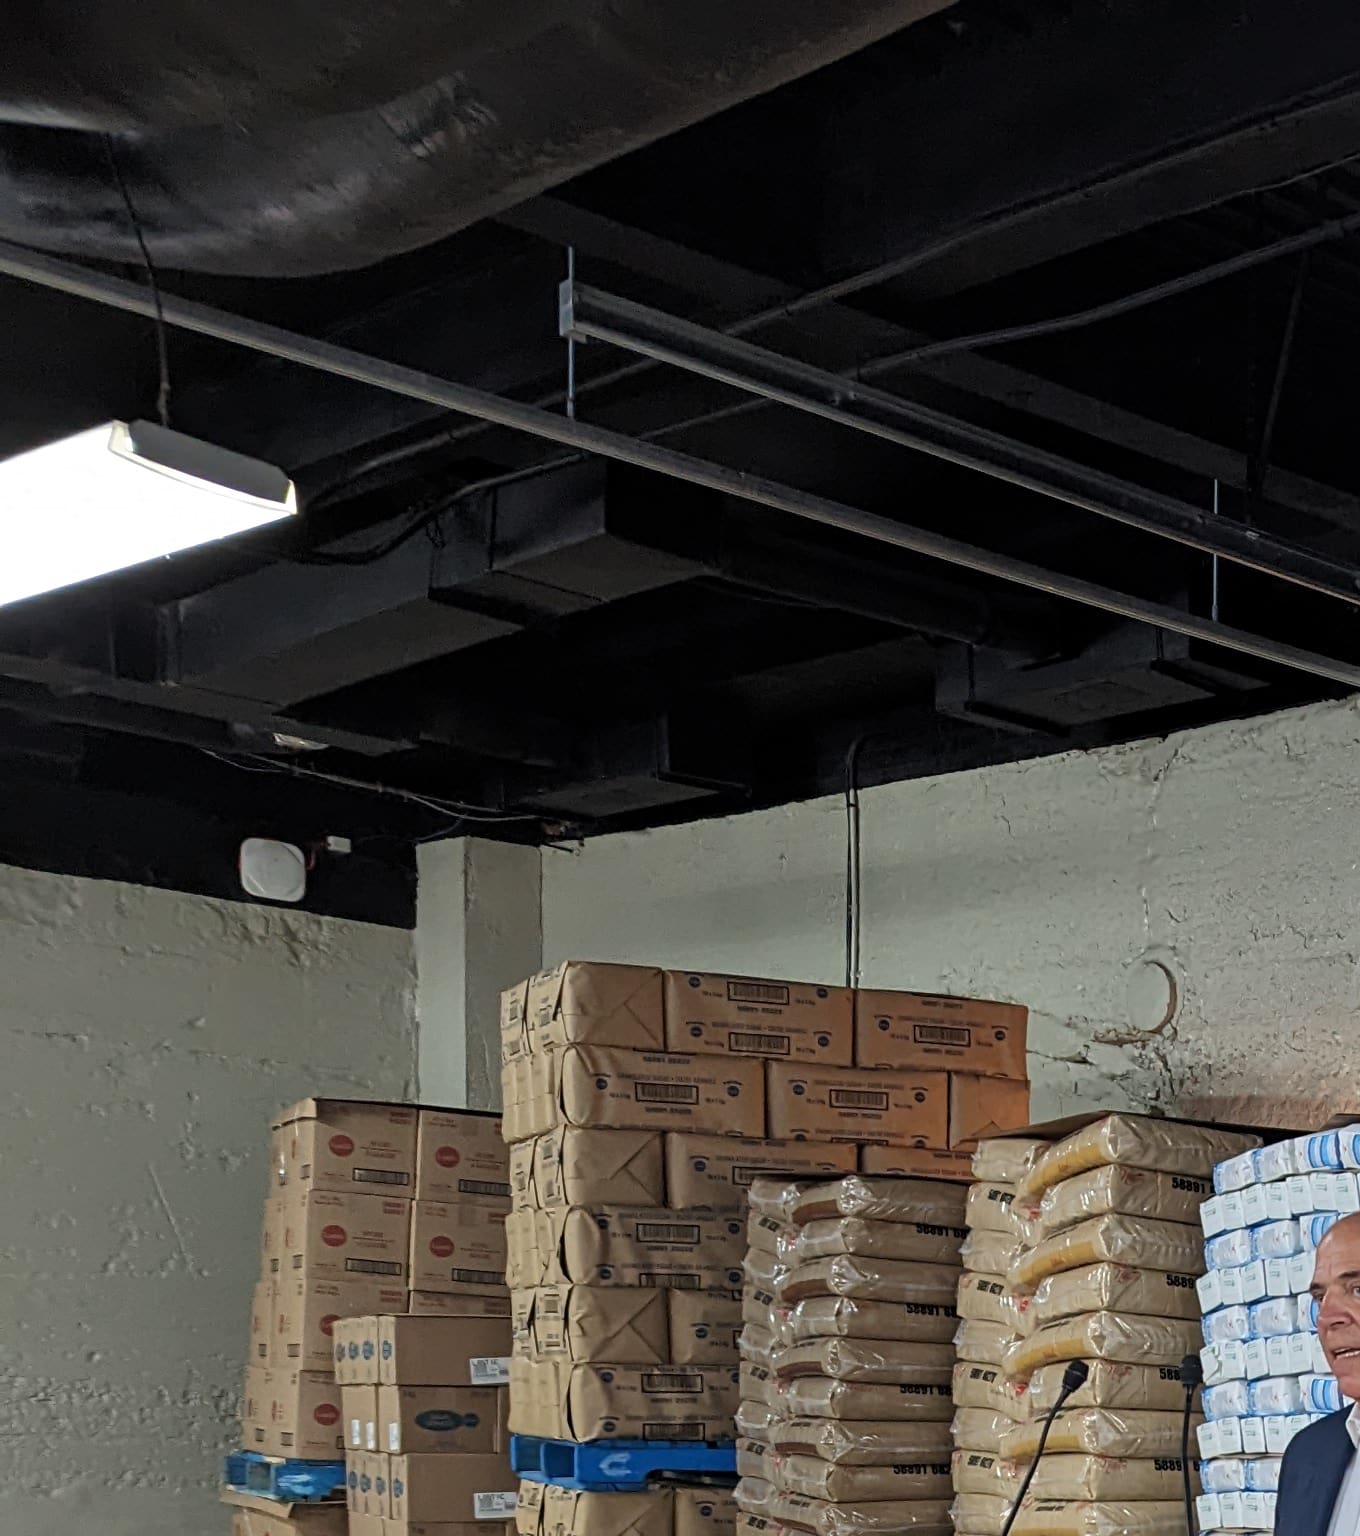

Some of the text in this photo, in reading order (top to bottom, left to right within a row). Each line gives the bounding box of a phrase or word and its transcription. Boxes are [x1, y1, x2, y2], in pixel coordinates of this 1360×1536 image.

[1171, 1176, 1205, 1193] 58891
[1166, 1274, 1194, 1289] 5889
[1154, 1460, 1182, 1471] 5889
